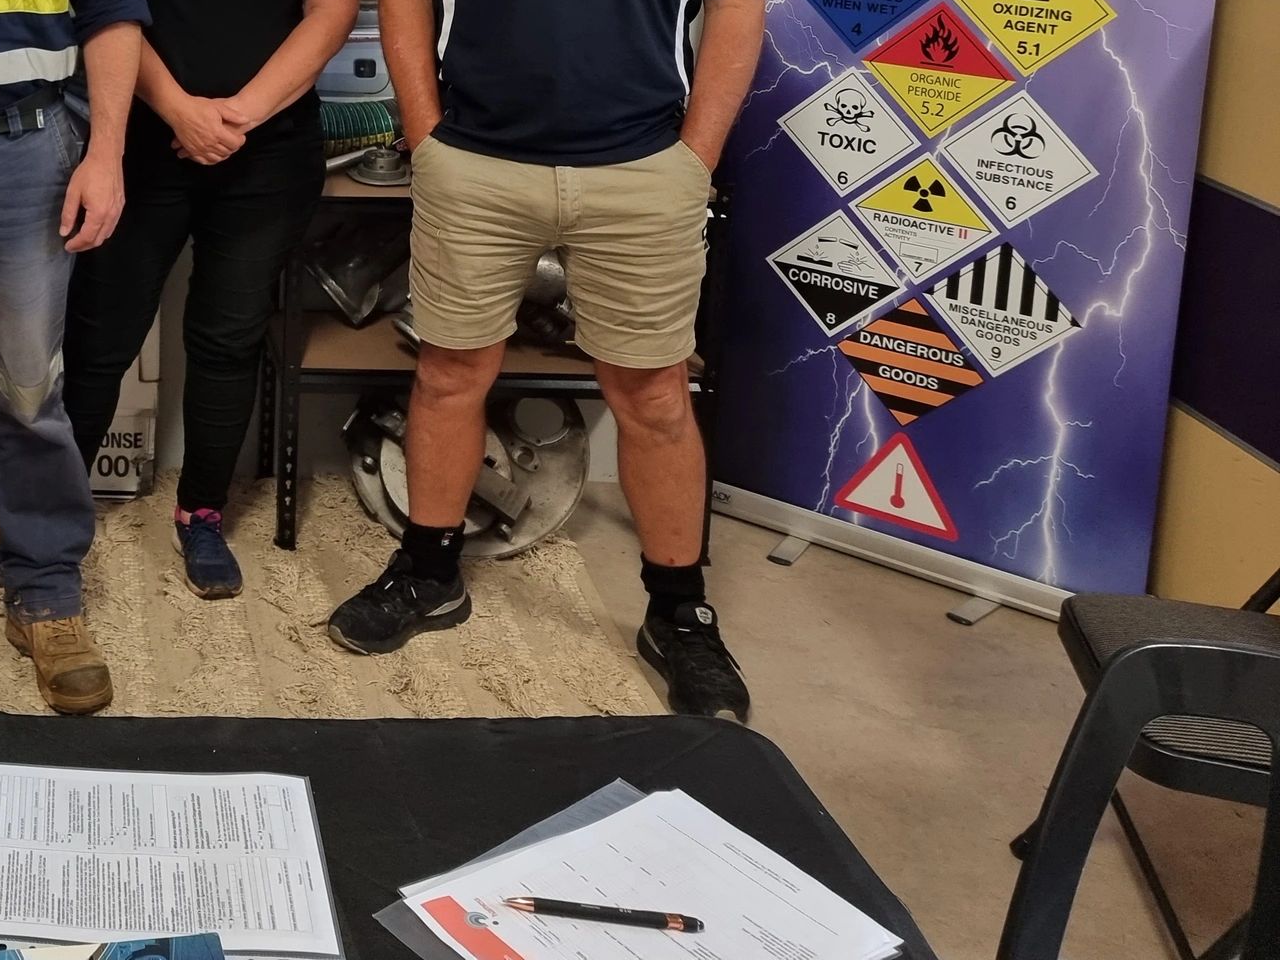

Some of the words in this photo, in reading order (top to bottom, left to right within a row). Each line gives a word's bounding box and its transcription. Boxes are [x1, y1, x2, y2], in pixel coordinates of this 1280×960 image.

[867, 2, 897, 15] WET
[993, 3, 1072, 21] OXIDIZING
[1003, 20, 1058, 35] AGENT
[1017, 42, 1040, 56] 5.1
[910, 72, 961, 88] ORGANIC
[908, 86, 962, 102] PEROXIDE
[921, 102, 944, 117] 5.2
[818, 131, 877, 154] TOXIC
[977, 159, 1054, 179] INFECTIOUS
[976, 171, 1053, 192] SUBSTANCE
[873, 212, 954, 236] RADIOACTIVE
[885, 226, 917, 237] CONTENTS
[885, 232, 910, 240] ACTIVITY
[789, 269, 879, 299] CORROSIVE
[949, 303, 1053, 334] MISCELLANEOUS
[961, 315, 1037, 341] DANGEROUS
[976, 330, 1020, 347] GOODS
[860, 331, 964, 366] DANGEROUS
[879, 366, 938, 390] GOODS
